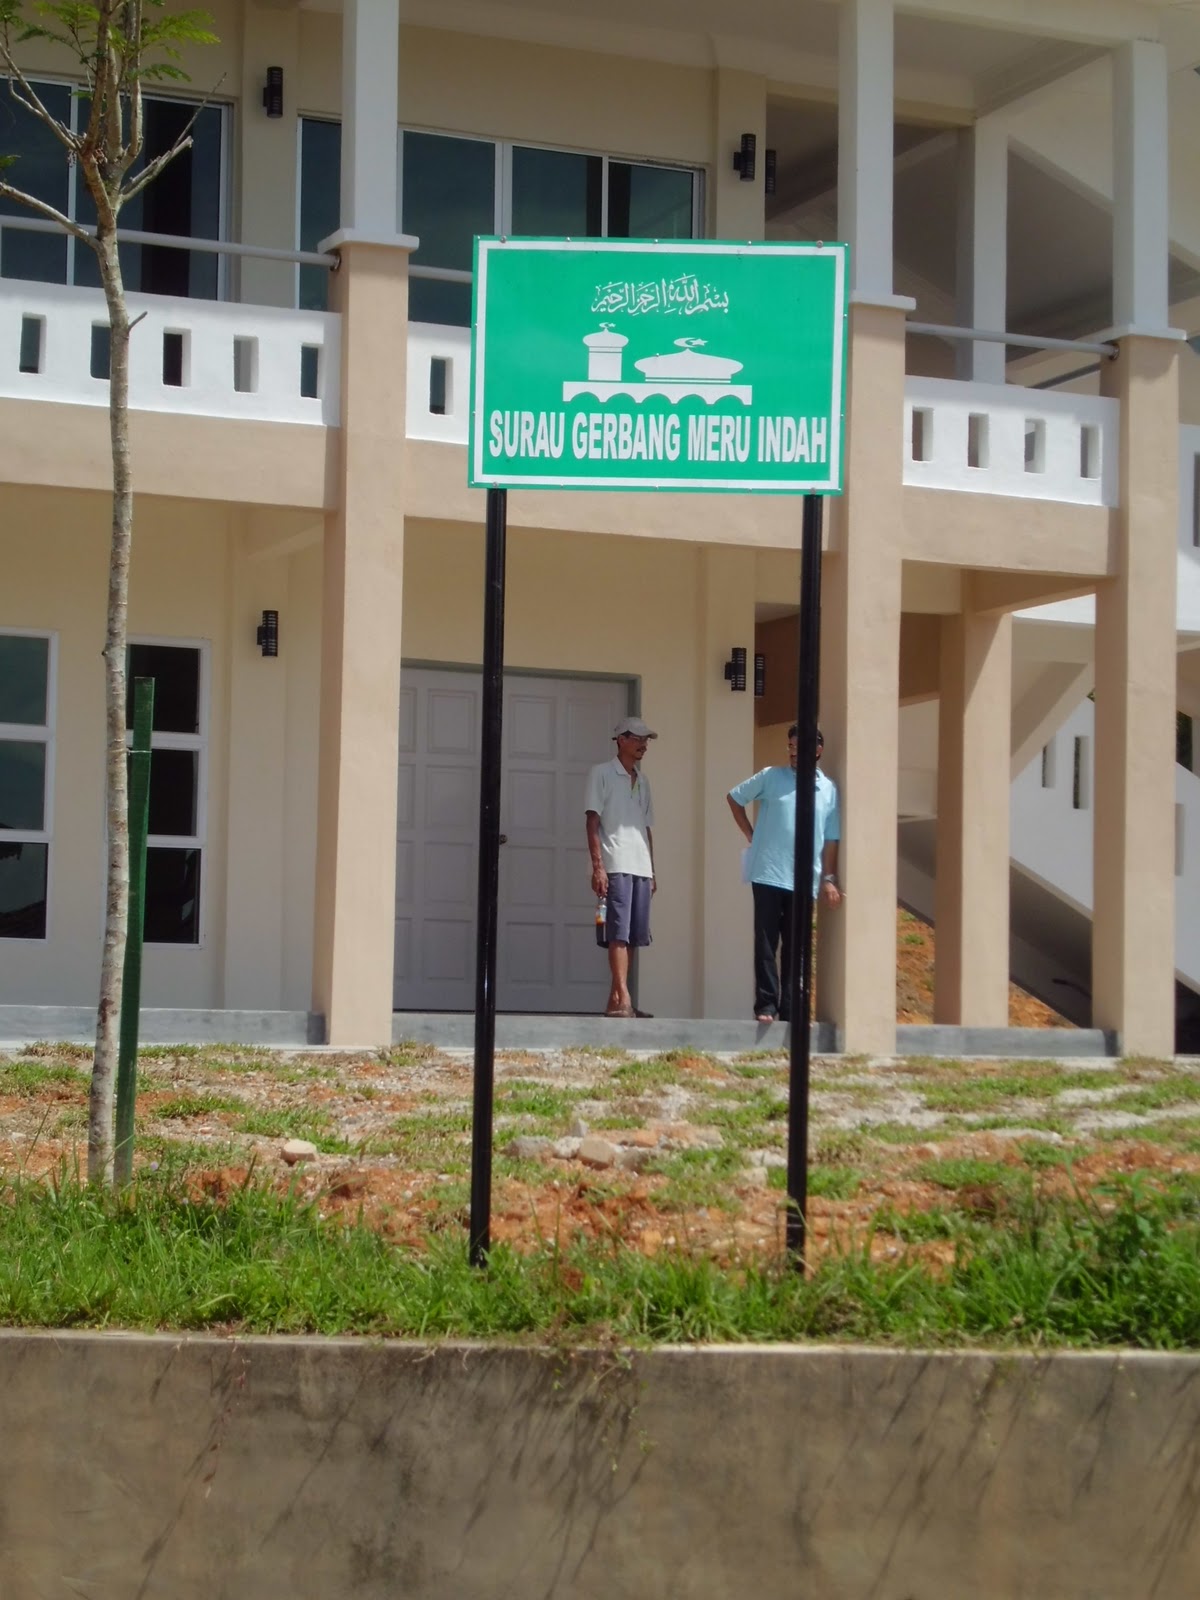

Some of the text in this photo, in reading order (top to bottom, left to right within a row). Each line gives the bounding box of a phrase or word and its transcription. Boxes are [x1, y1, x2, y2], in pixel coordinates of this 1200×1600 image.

[489, 409, 828, 464] SURAU GERBANG MERU INDAH
